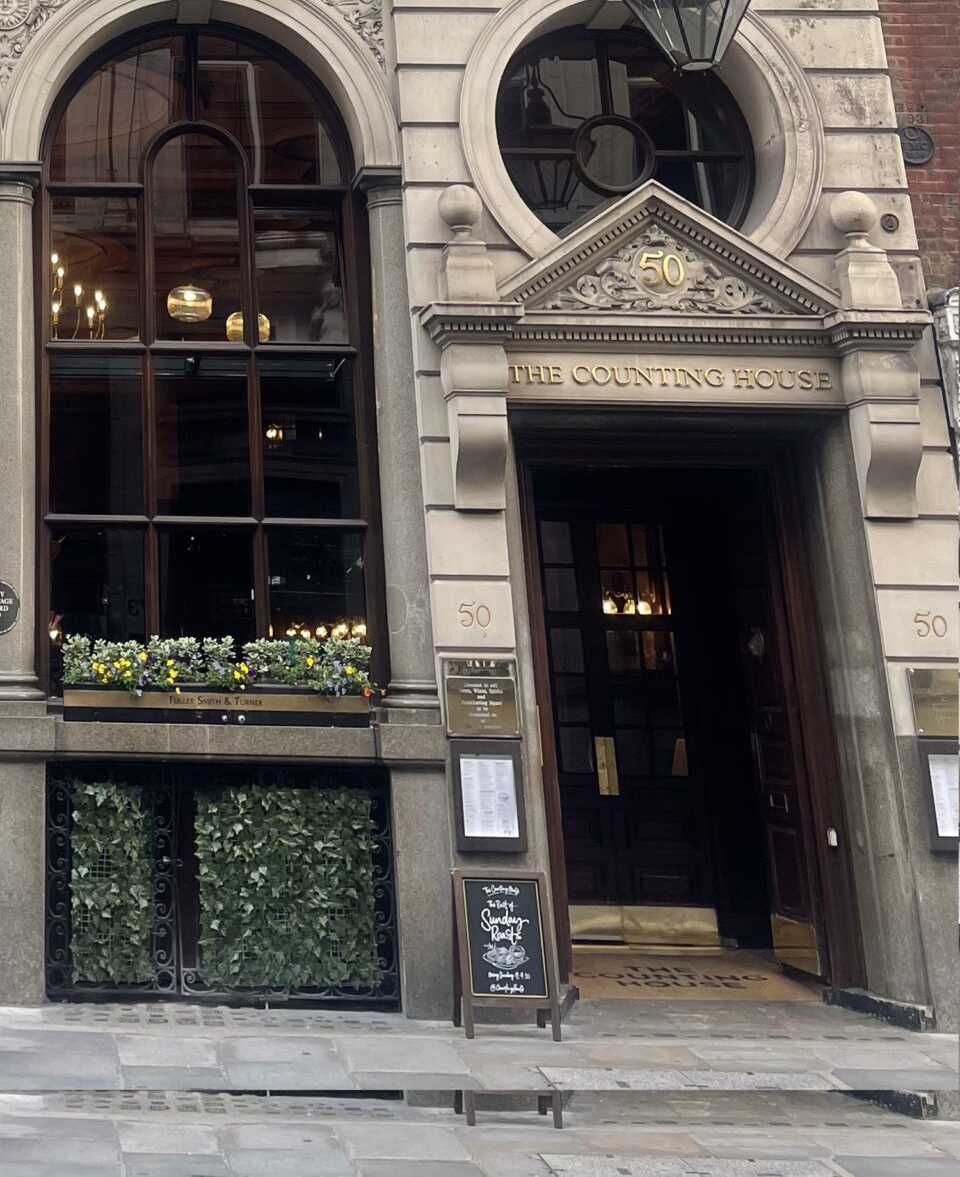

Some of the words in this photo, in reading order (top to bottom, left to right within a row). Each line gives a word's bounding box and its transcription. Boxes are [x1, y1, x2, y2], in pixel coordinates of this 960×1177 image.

[639, 251, 684, 287] 50
[509, 365, 564, 385] THE
[572, 366, 725, 388] COUNTING
[732, 368, 832, 390] HOUSE
[458, 602, 491, 628] 50
[913, 611, 948, 638] 50
[224, 696, 232, 706] &
[480, 908, 530, 932] Sunday
[491, 926, 522, 945] Roasts
[572, 972, 769, 981] COUNTING
[622, 966, 697, 974] THE
[615, 981, 749, 989] HOUSE
